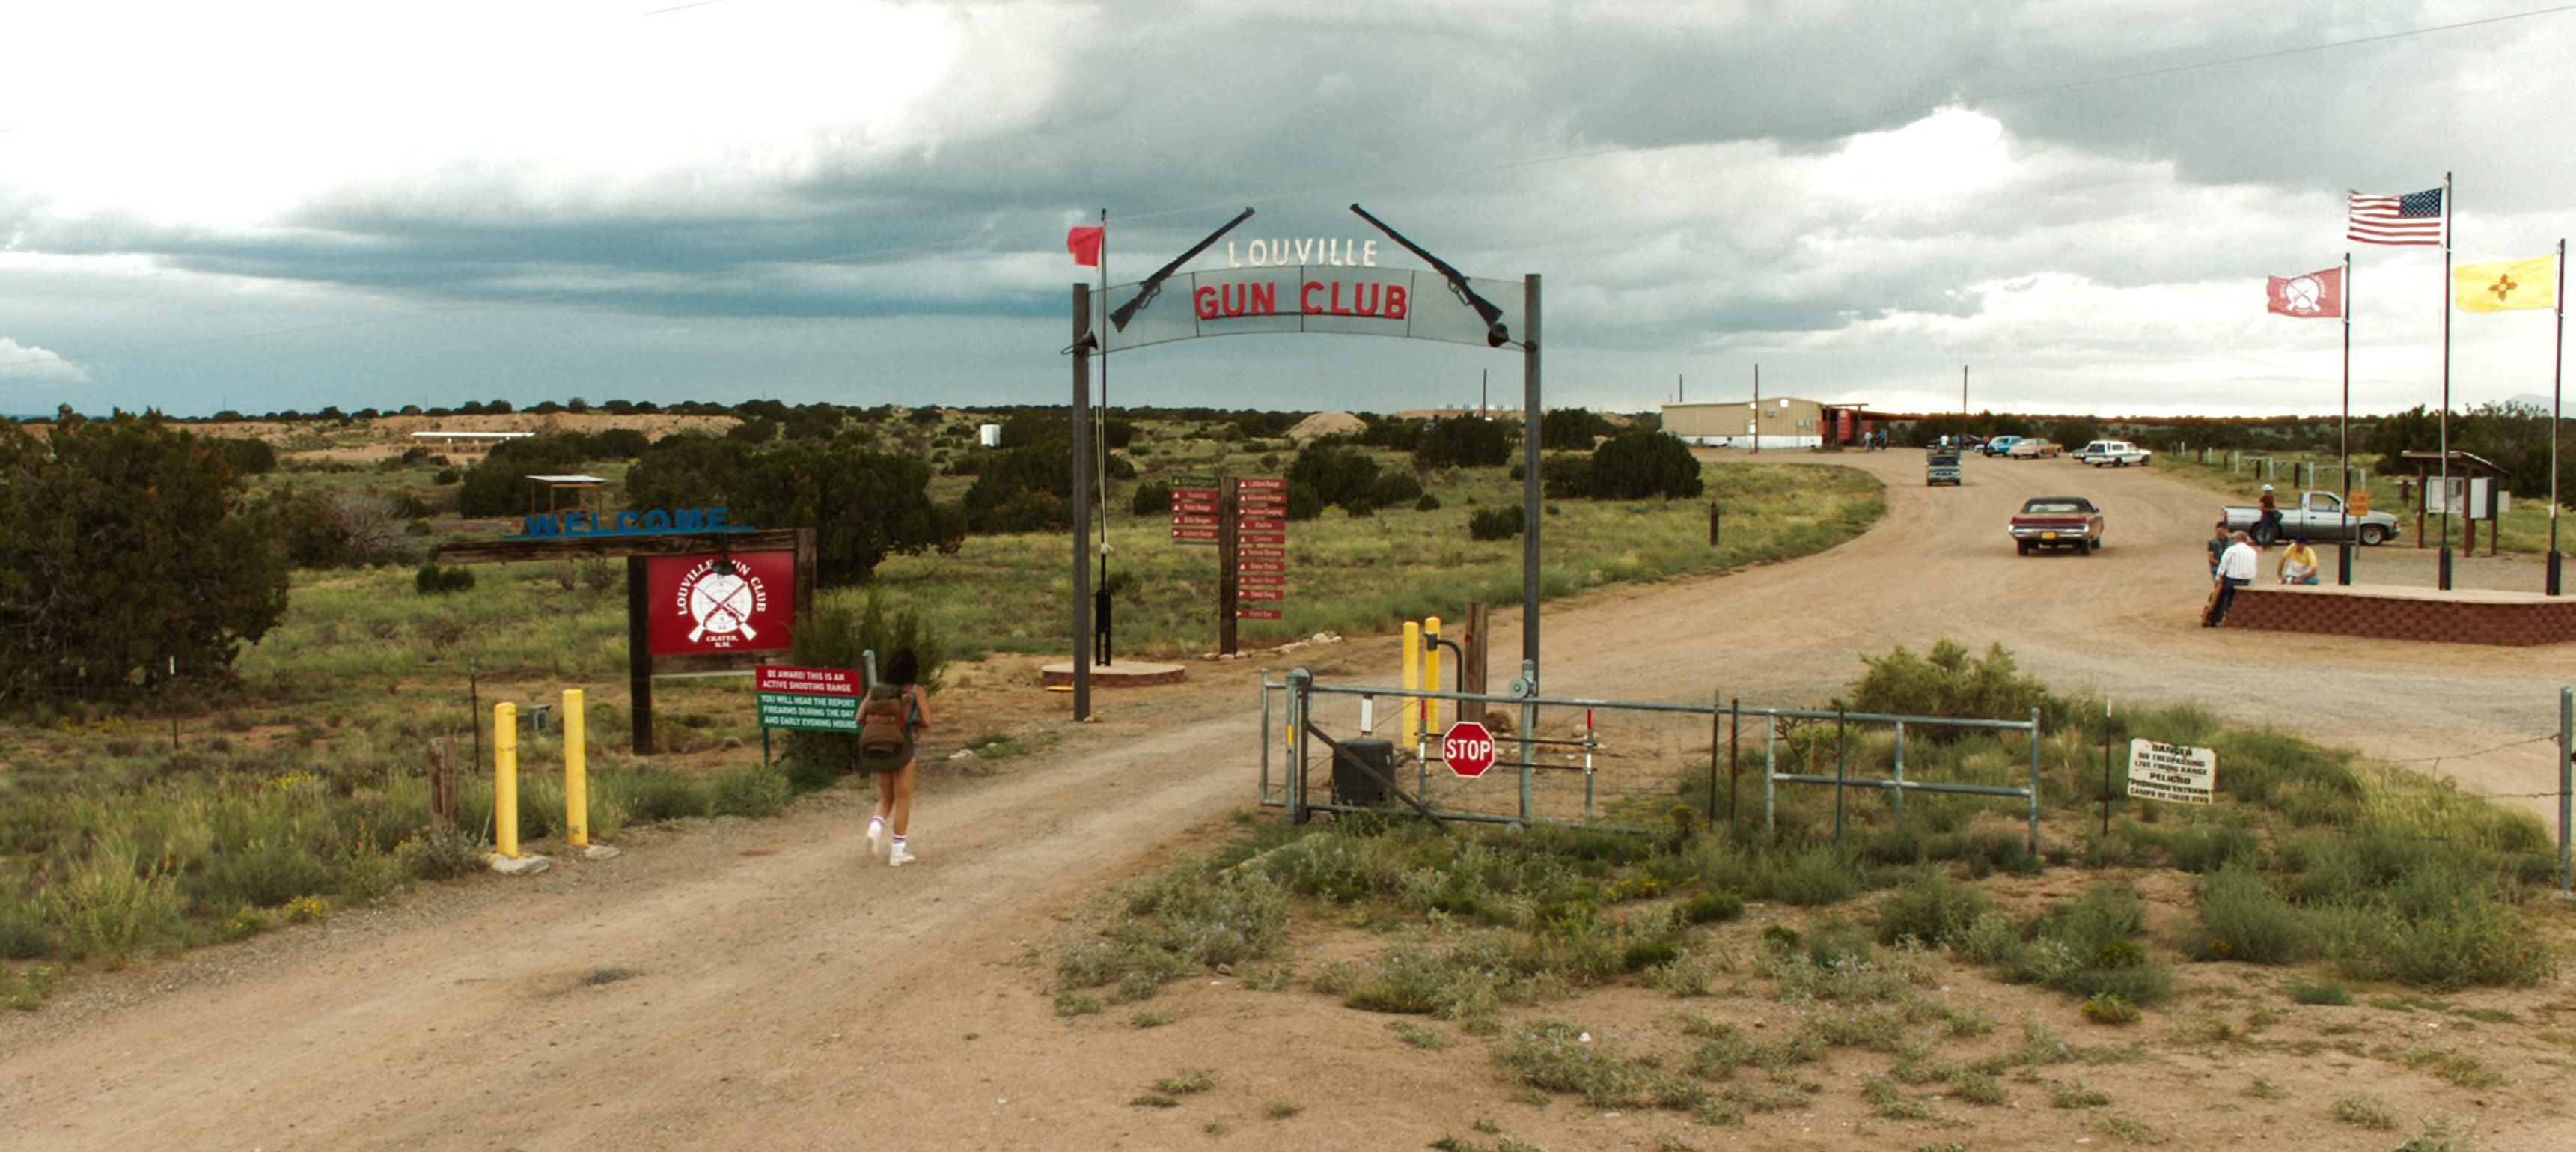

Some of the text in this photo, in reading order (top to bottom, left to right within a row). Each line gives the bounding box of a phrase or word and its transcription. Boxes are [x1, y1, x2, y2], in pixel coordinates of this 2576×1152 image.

[1228, 238, 1378, 268] LOUVILLE
[1194, 281, 1407, 319] GUN CLUB
[525, 507, 728, 537] WELCOME
[677, 559, 714, 616] LOUVILLE
[750, 577, 766, 612] CLUB
[778, 671, 805, 679] AWARE!
[806, 671, 822, 680] THIS
[825, 673, 832, 681] IS
[763, 680, 851, 692] ACTIVE SHOOTING RANGE
[761, 695, 855, 707] YOU WILL HEAR THE REPORT
[763, 705, 797, 715] FIREARMS
[798, 707, 825, 716] DURING
[840, 710, 855, 718] DAY
[780, 716, 801, 725] EARLY
[802, 718, 831, 727] EVENING
[832, 719, 858, 728] HOURS
[1446, 738, 1491, 761] STOP
[2153, 763, 2179, 772] FIRING
[2180, 767, 2207, 775] RANGE
[2149, 772, 2191, 784] PELIGRO
[2130, 787, 2155, 796] CAMPO
[2167, 793, 2190, 801] FUEGO
